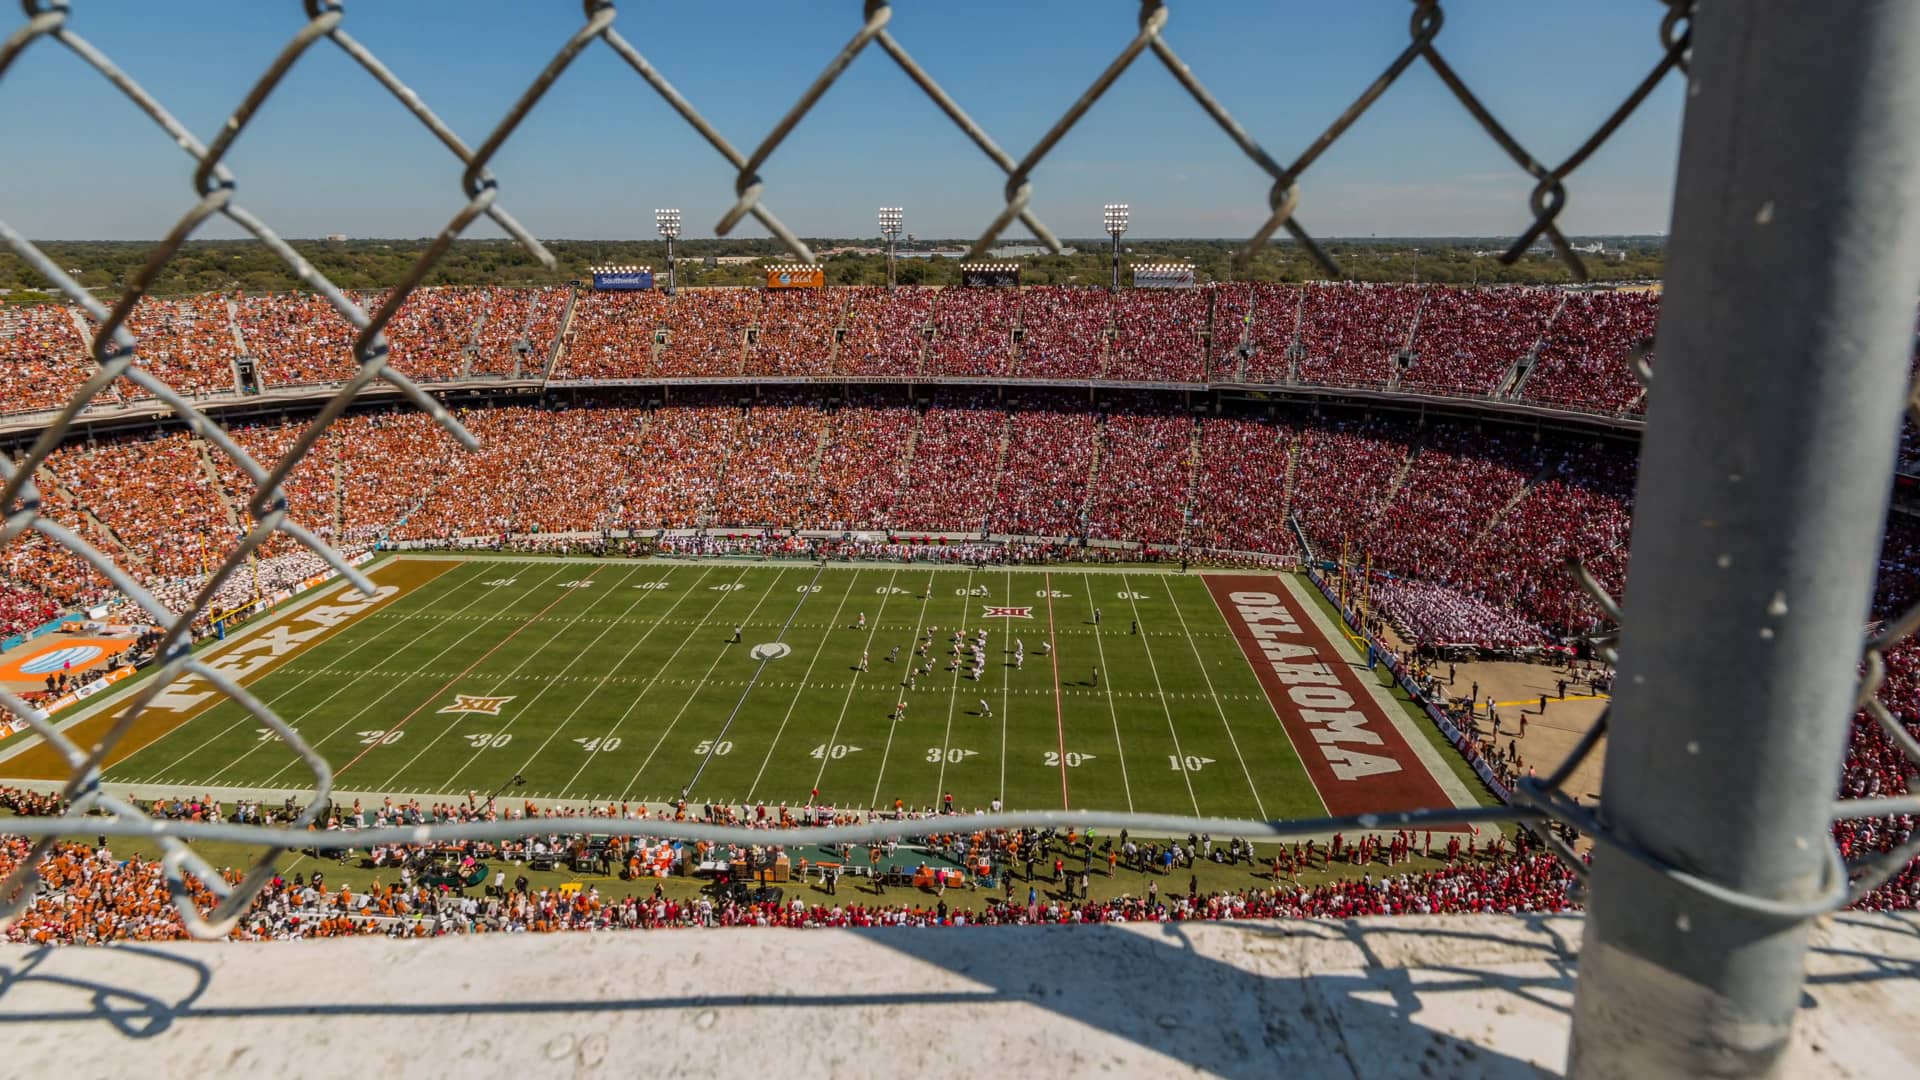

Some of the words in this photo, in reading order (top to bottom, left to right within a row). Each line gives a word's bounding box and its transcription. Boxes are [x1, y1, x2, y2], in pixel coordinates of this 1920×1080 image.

[110, 585, 399, 718] TEXAS
[1229, 591, 1403, 781] OKLAHOMA
[360, 730, 405, 744] 20
[470, 733, 513, 748] 30
[583, 737, 622, 752] 40
[694, 740, 734, 756] 50
[810, 743, 848, 759] 40
[926, 748, 963, 764] 30
[1044, 751, 1082, 767] 20
[1168, 755, 1203, 771] 10
